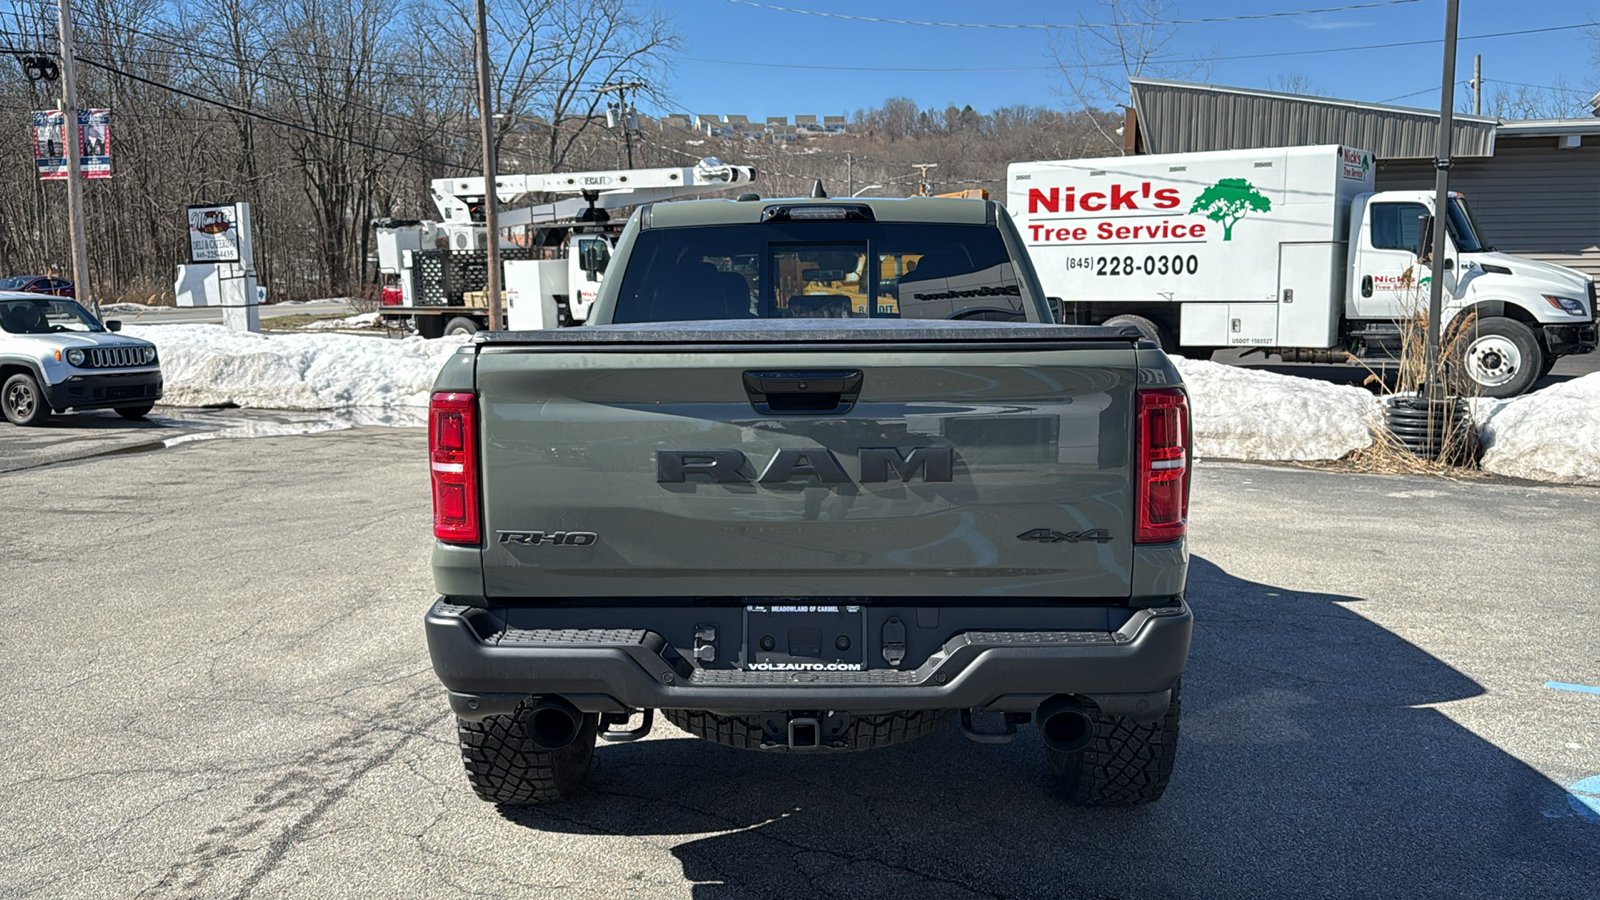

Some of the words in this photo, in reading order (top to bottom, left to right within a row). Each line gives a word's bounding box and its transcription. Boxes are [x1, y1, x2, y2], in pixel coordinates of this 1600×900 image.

[1028, 181, 1181, 214] Nick's
[1028, 224, 1087, 242] Tree
[1096, 220, 1206, 241] Service
[193, 240, 204, 250] DELI
[1065, 256, 1094, 271] (845)
[1096, 254, 1199, 276] 228-0300
[656, 446, 953, 484] RAM
[496, 530, 598, 546] RHO
[1016, 528, 1114, 544] 4x4
[748, 663, 861, 671] VOLZAUTO.COM
